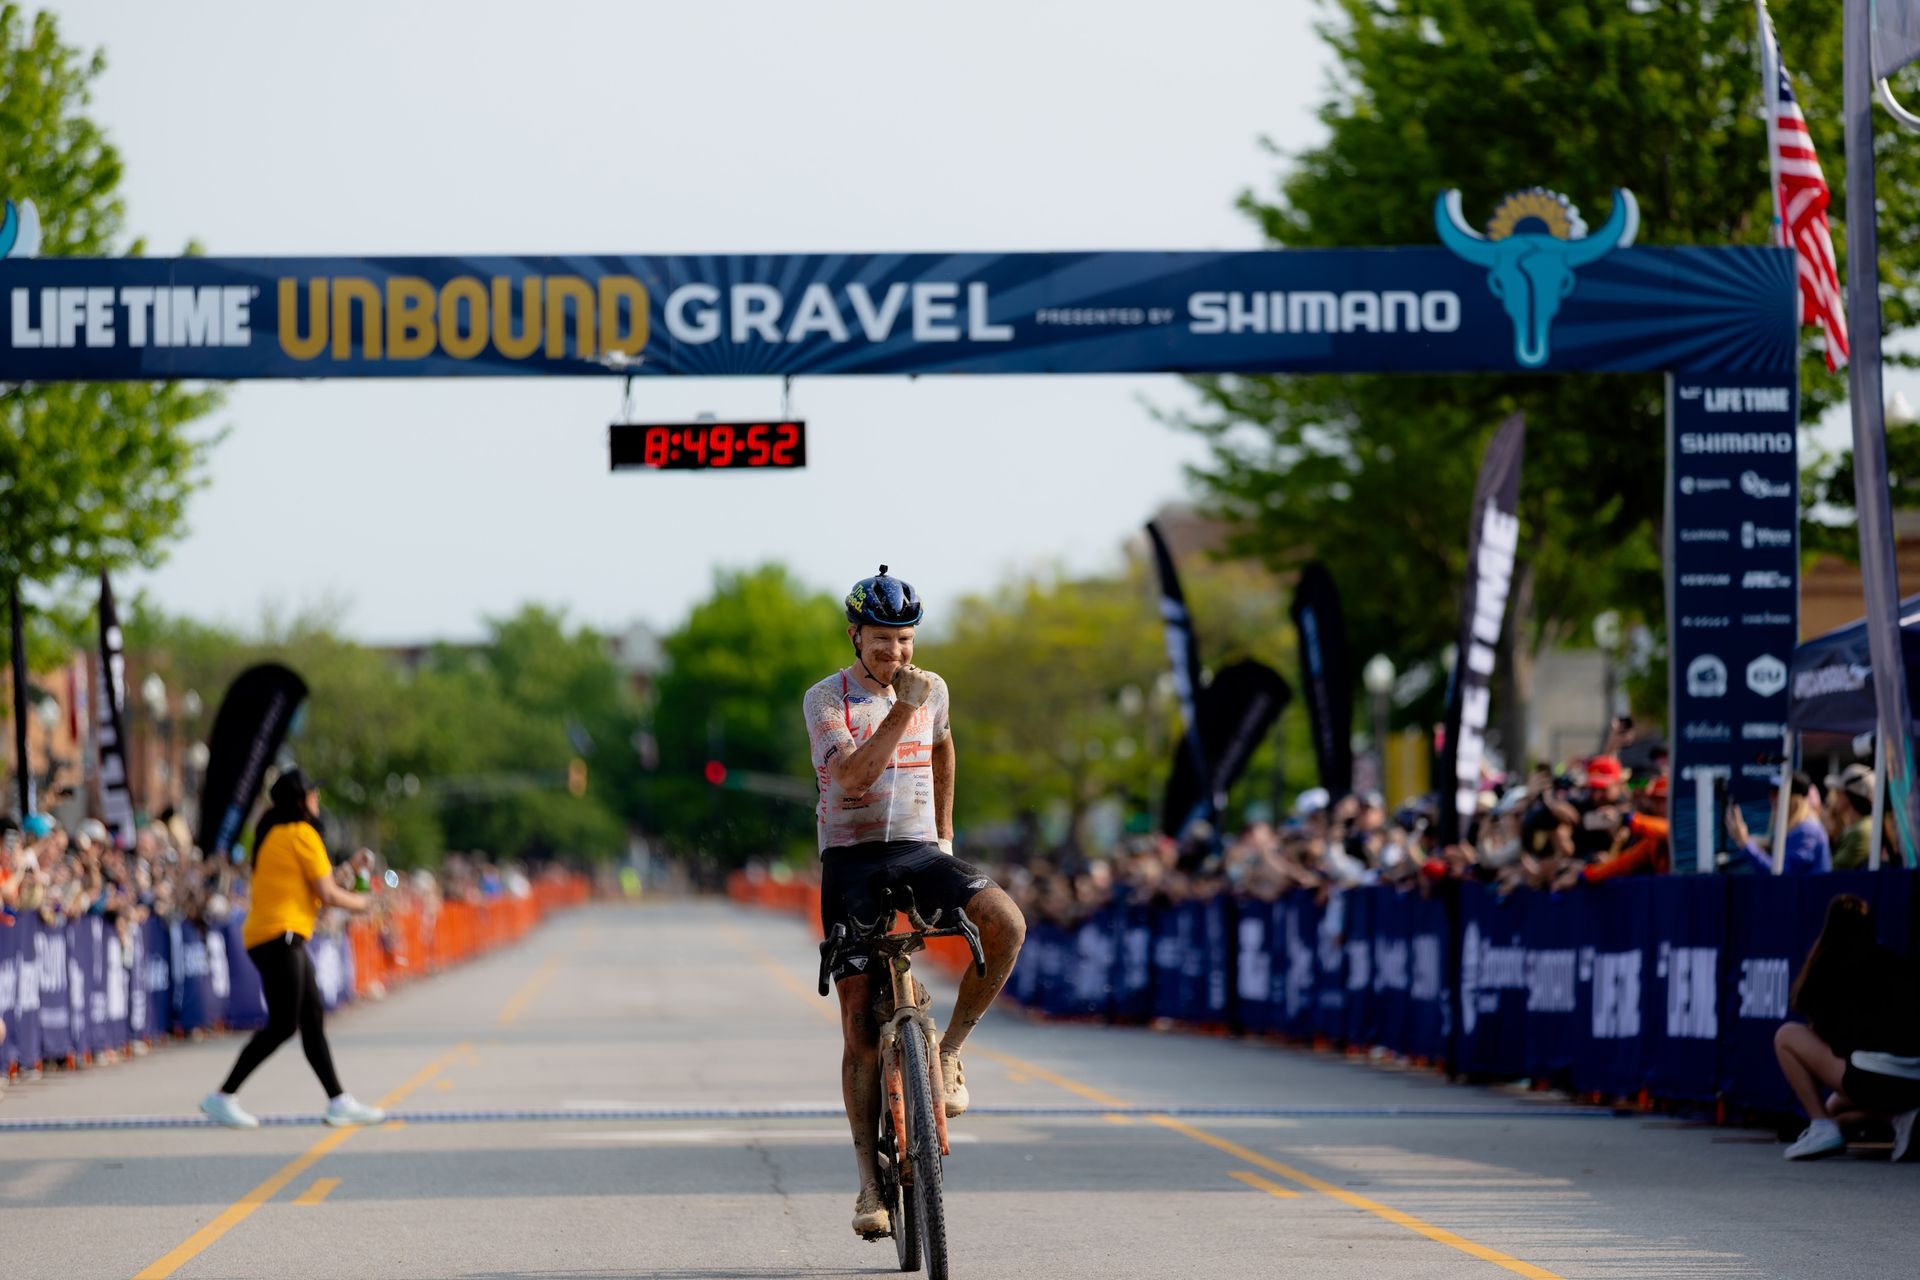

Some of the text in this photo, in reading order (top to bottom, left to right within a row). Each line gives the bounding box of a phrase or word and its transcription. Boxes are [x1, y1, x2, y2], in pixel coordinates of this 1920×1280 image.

[278, 275, 649, 361] UNBOUND
[664, 282, 1014, 344] GRAVEL
[1036, 307, 1174, 325] PRESENTED BY
[1188, 290, 1461, 334] SHIMANO
[1680, 432, 1792, 454] SHIMANO
